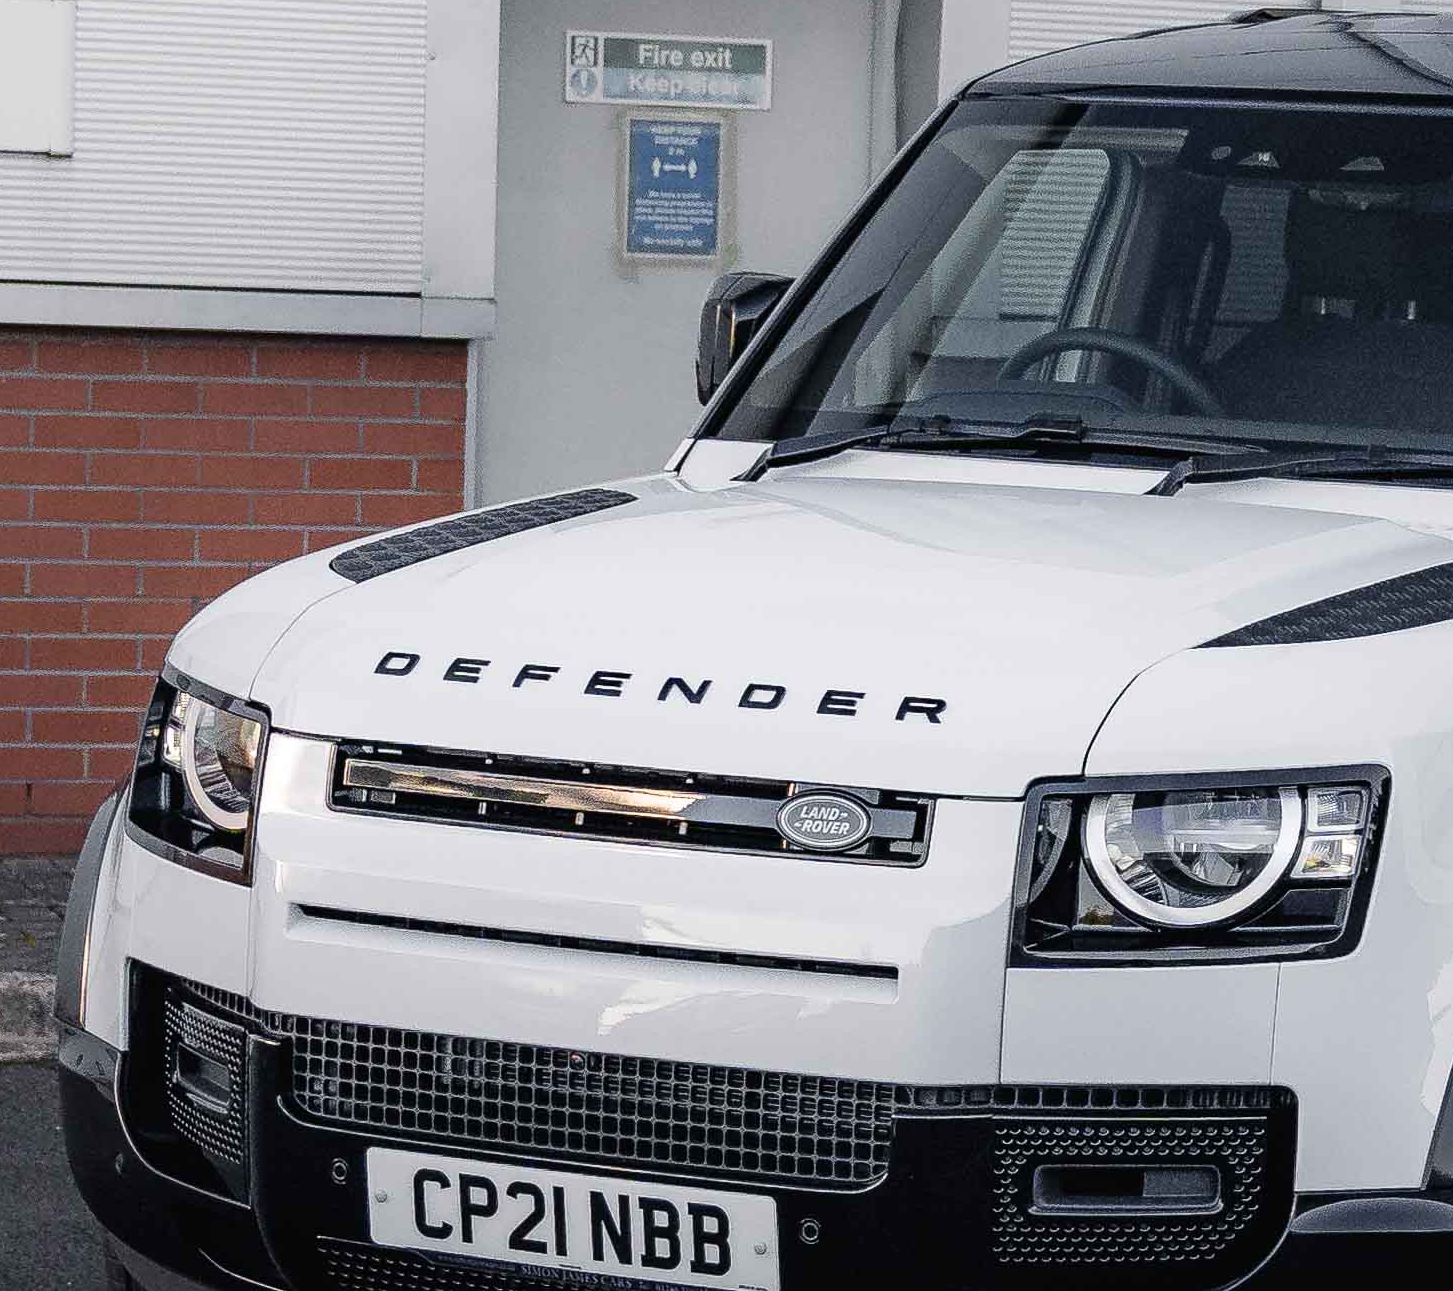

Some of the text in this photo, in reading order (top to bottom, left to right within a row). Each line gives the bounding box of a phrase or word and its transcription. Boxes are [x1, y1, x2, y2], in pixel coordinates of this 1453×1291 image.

[638, 44, 733, 69] Fire exit
[628, 73, 683, 98] Keep
[373, 651, 947, 724] DEFENDER
[800, 806, 840, 821] LAND
[801, 819, 850, 835] ROVER
[412, 1167, 732, 1277] CP21 NBB
[521, 1265, 560, 1279] SIMON
[561, 1269, 597, 1284] JAMES
[600, 1275, 632, 1289] CARS
